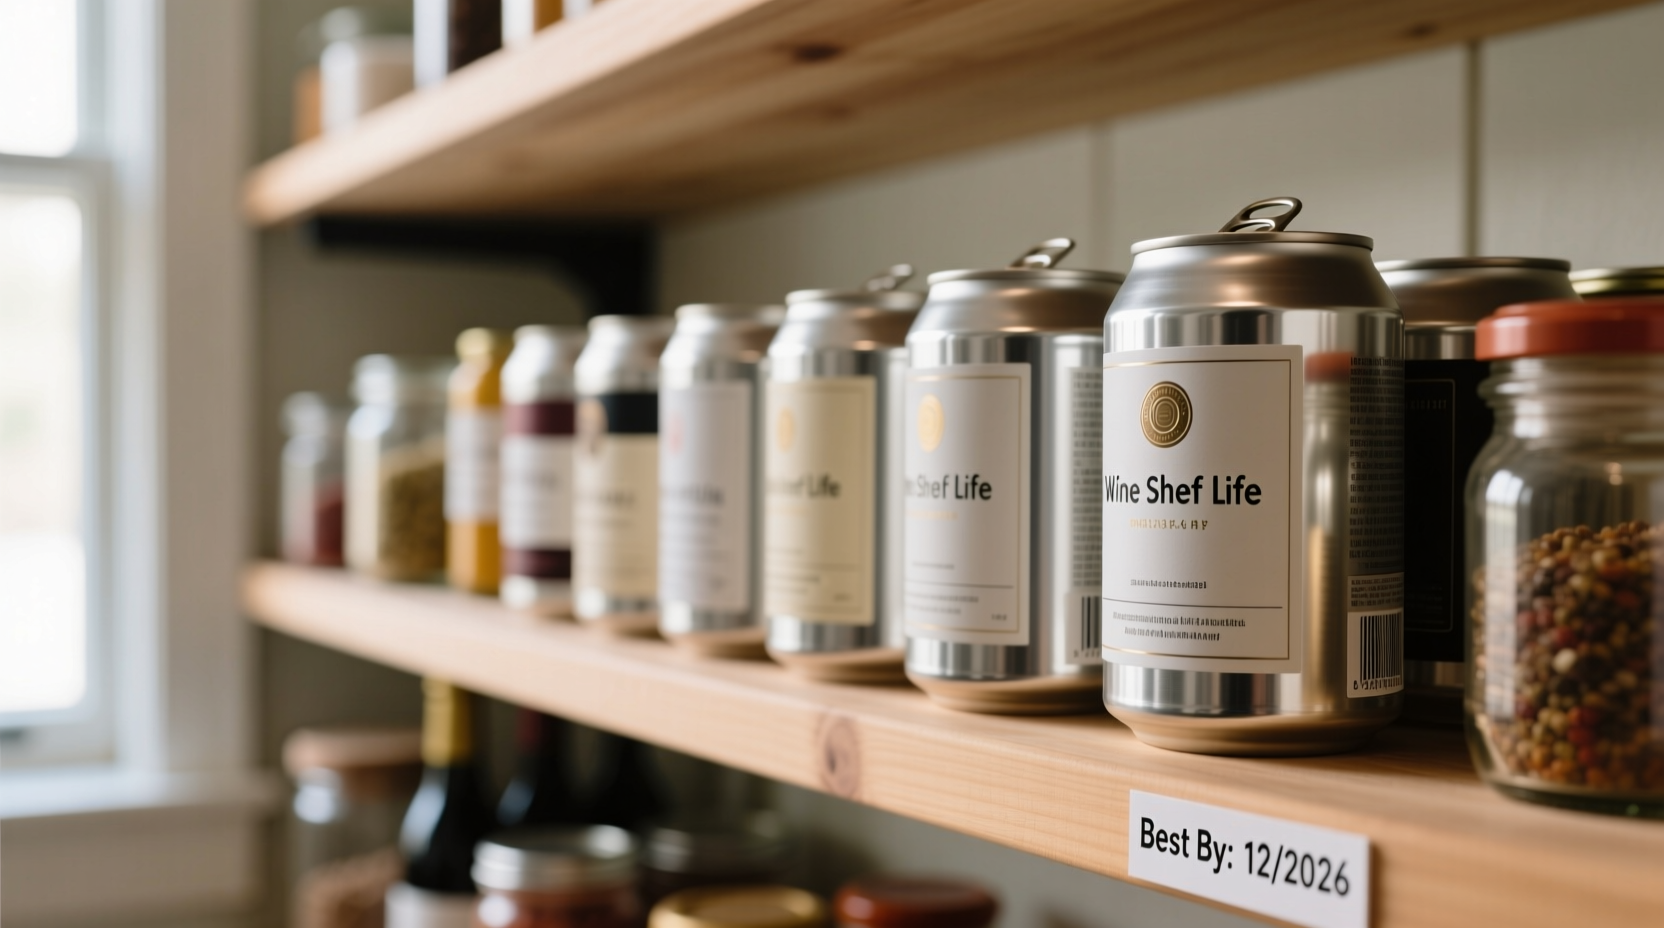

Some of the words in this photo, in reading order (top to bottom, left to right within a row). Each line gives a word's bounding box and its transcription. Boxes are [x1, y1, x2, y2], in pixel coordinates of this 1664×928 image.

[917, 474, 949, 499] Shef
[955, 474, 992, 501] Life
[1105, 475, 1140, 503] Wine
[1146, 474, 1204, 505] Shef
[1212, 474, 1262, 506] Life
[1140, 816, 1190, 858] Best
[1197, 828, 1233, 874] By:
[1244, 841, 1350, 896] 12/2026
